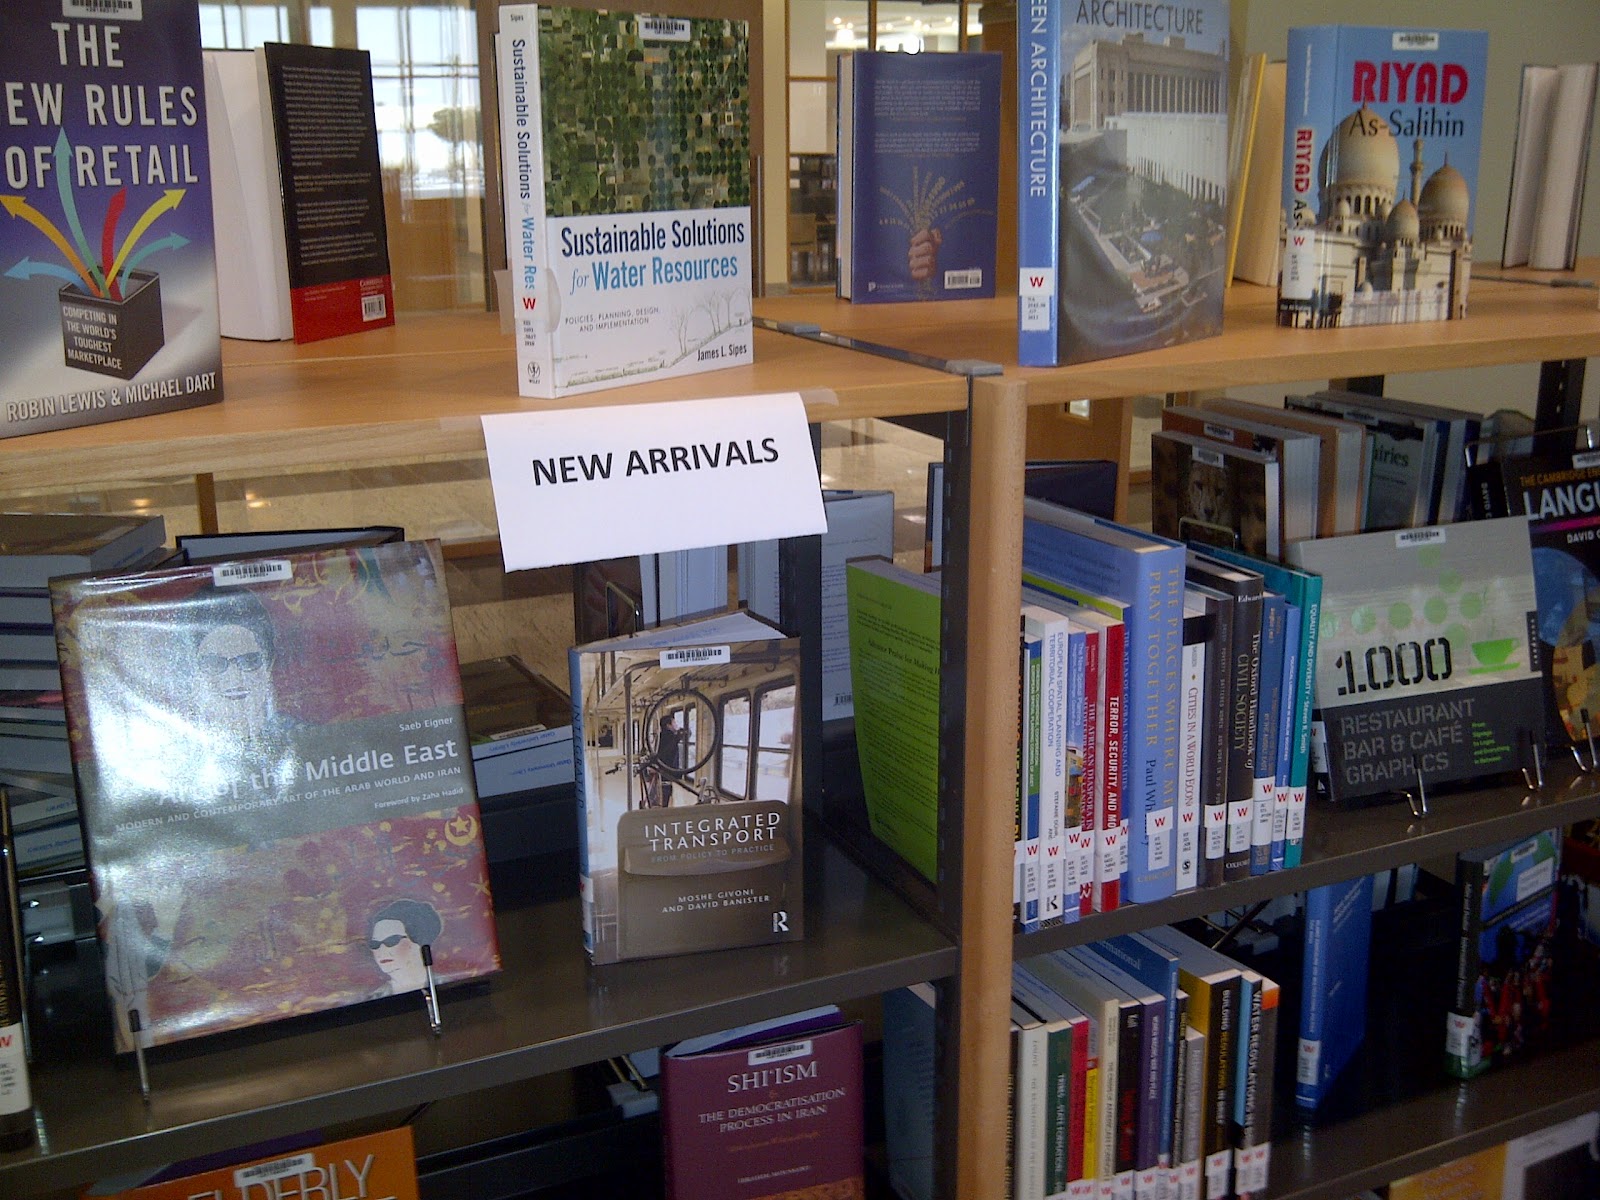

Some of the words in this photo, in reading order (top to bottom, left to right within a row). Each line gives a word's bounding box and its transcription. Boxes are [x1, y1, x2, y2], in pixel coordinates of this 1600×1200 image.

[1076, 0, 1203, 34] ARCHITECTURE
[51, 22, 124, 67] THE
[512, 39, 529, 126] Sustainable
[1352, 60, 1469, 104] RIYAD
[5, 82, 63, 126] EW
[85, 84, 198, 127] RULES
[1031, 42, 1047, 197] ARCHITECTURE
[1349, 107, 1464, 137] As-Salihin
[5, 145, 52, 190] OF
[75, 144, 199, 187] RETAIL
[517, 131, 532, 199] Solutions
[1293, 129, 1313, 193] RIYAD
[522, 217, 535, 262] Water
[561, 222, 666, 257] Sustainable
[672, 218, 745, 248] Solutions
[570, 268, 590, 295] for
[592, 261, 646, 291] Water
[652, 256, 738, 285] Resources
[1030, 276, 1044, 287] W
[63, 306, 107, 323] COMPETING
[108, 313, 118, 325] IN
[522, 297, 536, 310] W
[565, 315, 595, 325] POLICIES,
[598, 309, 633, 321] PLANNING,
[66, 321, 80, 333] THE
[82, 323, 117, 340] WORLD'S
[579, 323, 594, 333] AND
[596, 317, 650, 331] IMPLEMENTATION
[67, 349, 123, 370] MARKETPLACE
[73, 336, 112, 353] TOUGHEST
[698, 346, 720, 361] James
[721, 346, 727, 357] L.
[729, 343, 747, 357] Sipes
[6, 397, 56, 422] ROBIN
[59, 389, 107, 414] LEWIS
[111, 388, 122, 406] &
[125, 379, 183, 404] MICHAEL
[185, 371, 216, 395] DART
[532, 452, 613, 486] NEW
[625, 437, 779, 477] ARRIVALS
[1567, 530, 1595, 544] DAVID
[1148, 571, 1161, 621] PRAY
[1167, 565, 1179, 608] THE
[1309, 604, 1318, 640] EQUALITY
[1056, 632, 1064, 678] EUROPEAN
[1166, 617, 1179, 692] PLACES
[1252, 631, 1261, 654] The
[1048, 634, 1056, 687] TERRITORIAL
[1236, 653, 1250, 692] CIVIL
[1250, 657, 1260, 696] Oxford
[1304, 659, 1313, 695] DIVERSITY
[1123, 679, 1129, 690] OF
[1146, 630, 1160, 747] TOGETHER
[1047, 689, 1055, 747] COOPERATION
[1075, 697, 1083, 726] Planning
[1088, 703, 1096, 721] THE
[1108, 696, 1120, 738] TERROR,
[1188, 687, 1199, 720] CITIES
[1340, 698, 1475, 737] RESTAURANT
[399, 722, 422, 733] Saeb
[424, 717, 453, 730] Eigner
[1055, 714, 1063, 757] PLANNING
[1164, 699, 1177, 769] WHERE
[1187, 722, 1196, 731] IN
[1233, 694, 1248, 752] SOCIETY
[1247, 699, 1258, 756] Handbook
[1087, 725, 1095, 766] AFRICAN
[1299, 733, 1307, 754] Smith
[1343, 739, 1385, 761] BAR
[1390, 733, 1406, 752] &
[1409, 720, 1463, 750] CAFÉ
[305, 749, 394, 782] Middle
[404, 739, 458, 765] East
[1107, 740, 1119, 789] SECURITY,
[1145, 760, 1157, 787] Paul
[1185, 741, 1196, 777] WORLD
[1245, 759, 1254, 769] of
[1345, 751, 1450, 785] GRAPHCS
[115, 817, 163, 832] MODERN
[167, 812, 190, 824] AND
[193, 798, 279, 819] CONTEMPORARY
[283, 794, 302, 804] ART
[305, 791, 319, 800] OF
[322, 787, 341, 797] THE
[344, 782, 371, 793] ARAB
[374, 775, 410, 788] WORLD
[413, 772, 434, 782] AND
[437, 766, 461, 777] IRAN
[374, 797, 409, 809] Foreword
[411, 793, 420, 803] by
[422, 791, 440, 801] Zaha
[442, 787, 464, 797] Hadid
[1086, 769, 1095, 818] DIASPORA
[1107, 792, 1117, 808] AND
[1263, 783, 1273, 793] W
[1277, 793, 1287, 803] W
[1294, 793, 1304, 803] W
[644, 812, 781, 838] INTEGRATED
[1086, 819, 1094, 829] IN
[1155, 816, 1165, 827] W
[1183, 812, 1193, 823] W
[1213, 810, 1224, 820] W
[1237, 807, 1248, 817] W
[649, 826, 777, 852] TRANSPORT
[651, 854, 676, 863] FROM
[681, 851, 713, 861] POLICY
[716, 848, 728, 857] TO
[731, 843, 775, 855] PRACTICE
[1027, 844, 1038, 856] W
[1047, 845, 1059, 857] W
[1069, 833, 1080, 844] W
[1080, 837, 1091, 848] W
[1106, 834, 1117, 846] W
[662, 905, 685, 913] AND
[688, 900, 719, 911] DAVID
[722, 895, 770, 907] BANISTER
[678, 893, 713, 903] MOSHE
[717, 888, 755, 899] GIVONI
[772, 911, 790, 933] R
[1221, 989, 1231, 1031] BUILDING
[1251, 990, 1262, 1033] WATER
[1218, 1032, 1229, 1089] REGULATIONS
[1245, 1034, 1260, 1112] REGULATIONS
[698, 1110, 725, 1124] THE
[728, 1087, 846, 1119] DEMOCRATISATION
[1217, 1090, 1226, 1099] IN
[719, 1115, 775, 1133] PROCESS
[778, 1112, 791, 1122] IN
[796, 1104, 827, 1119] IRAN
